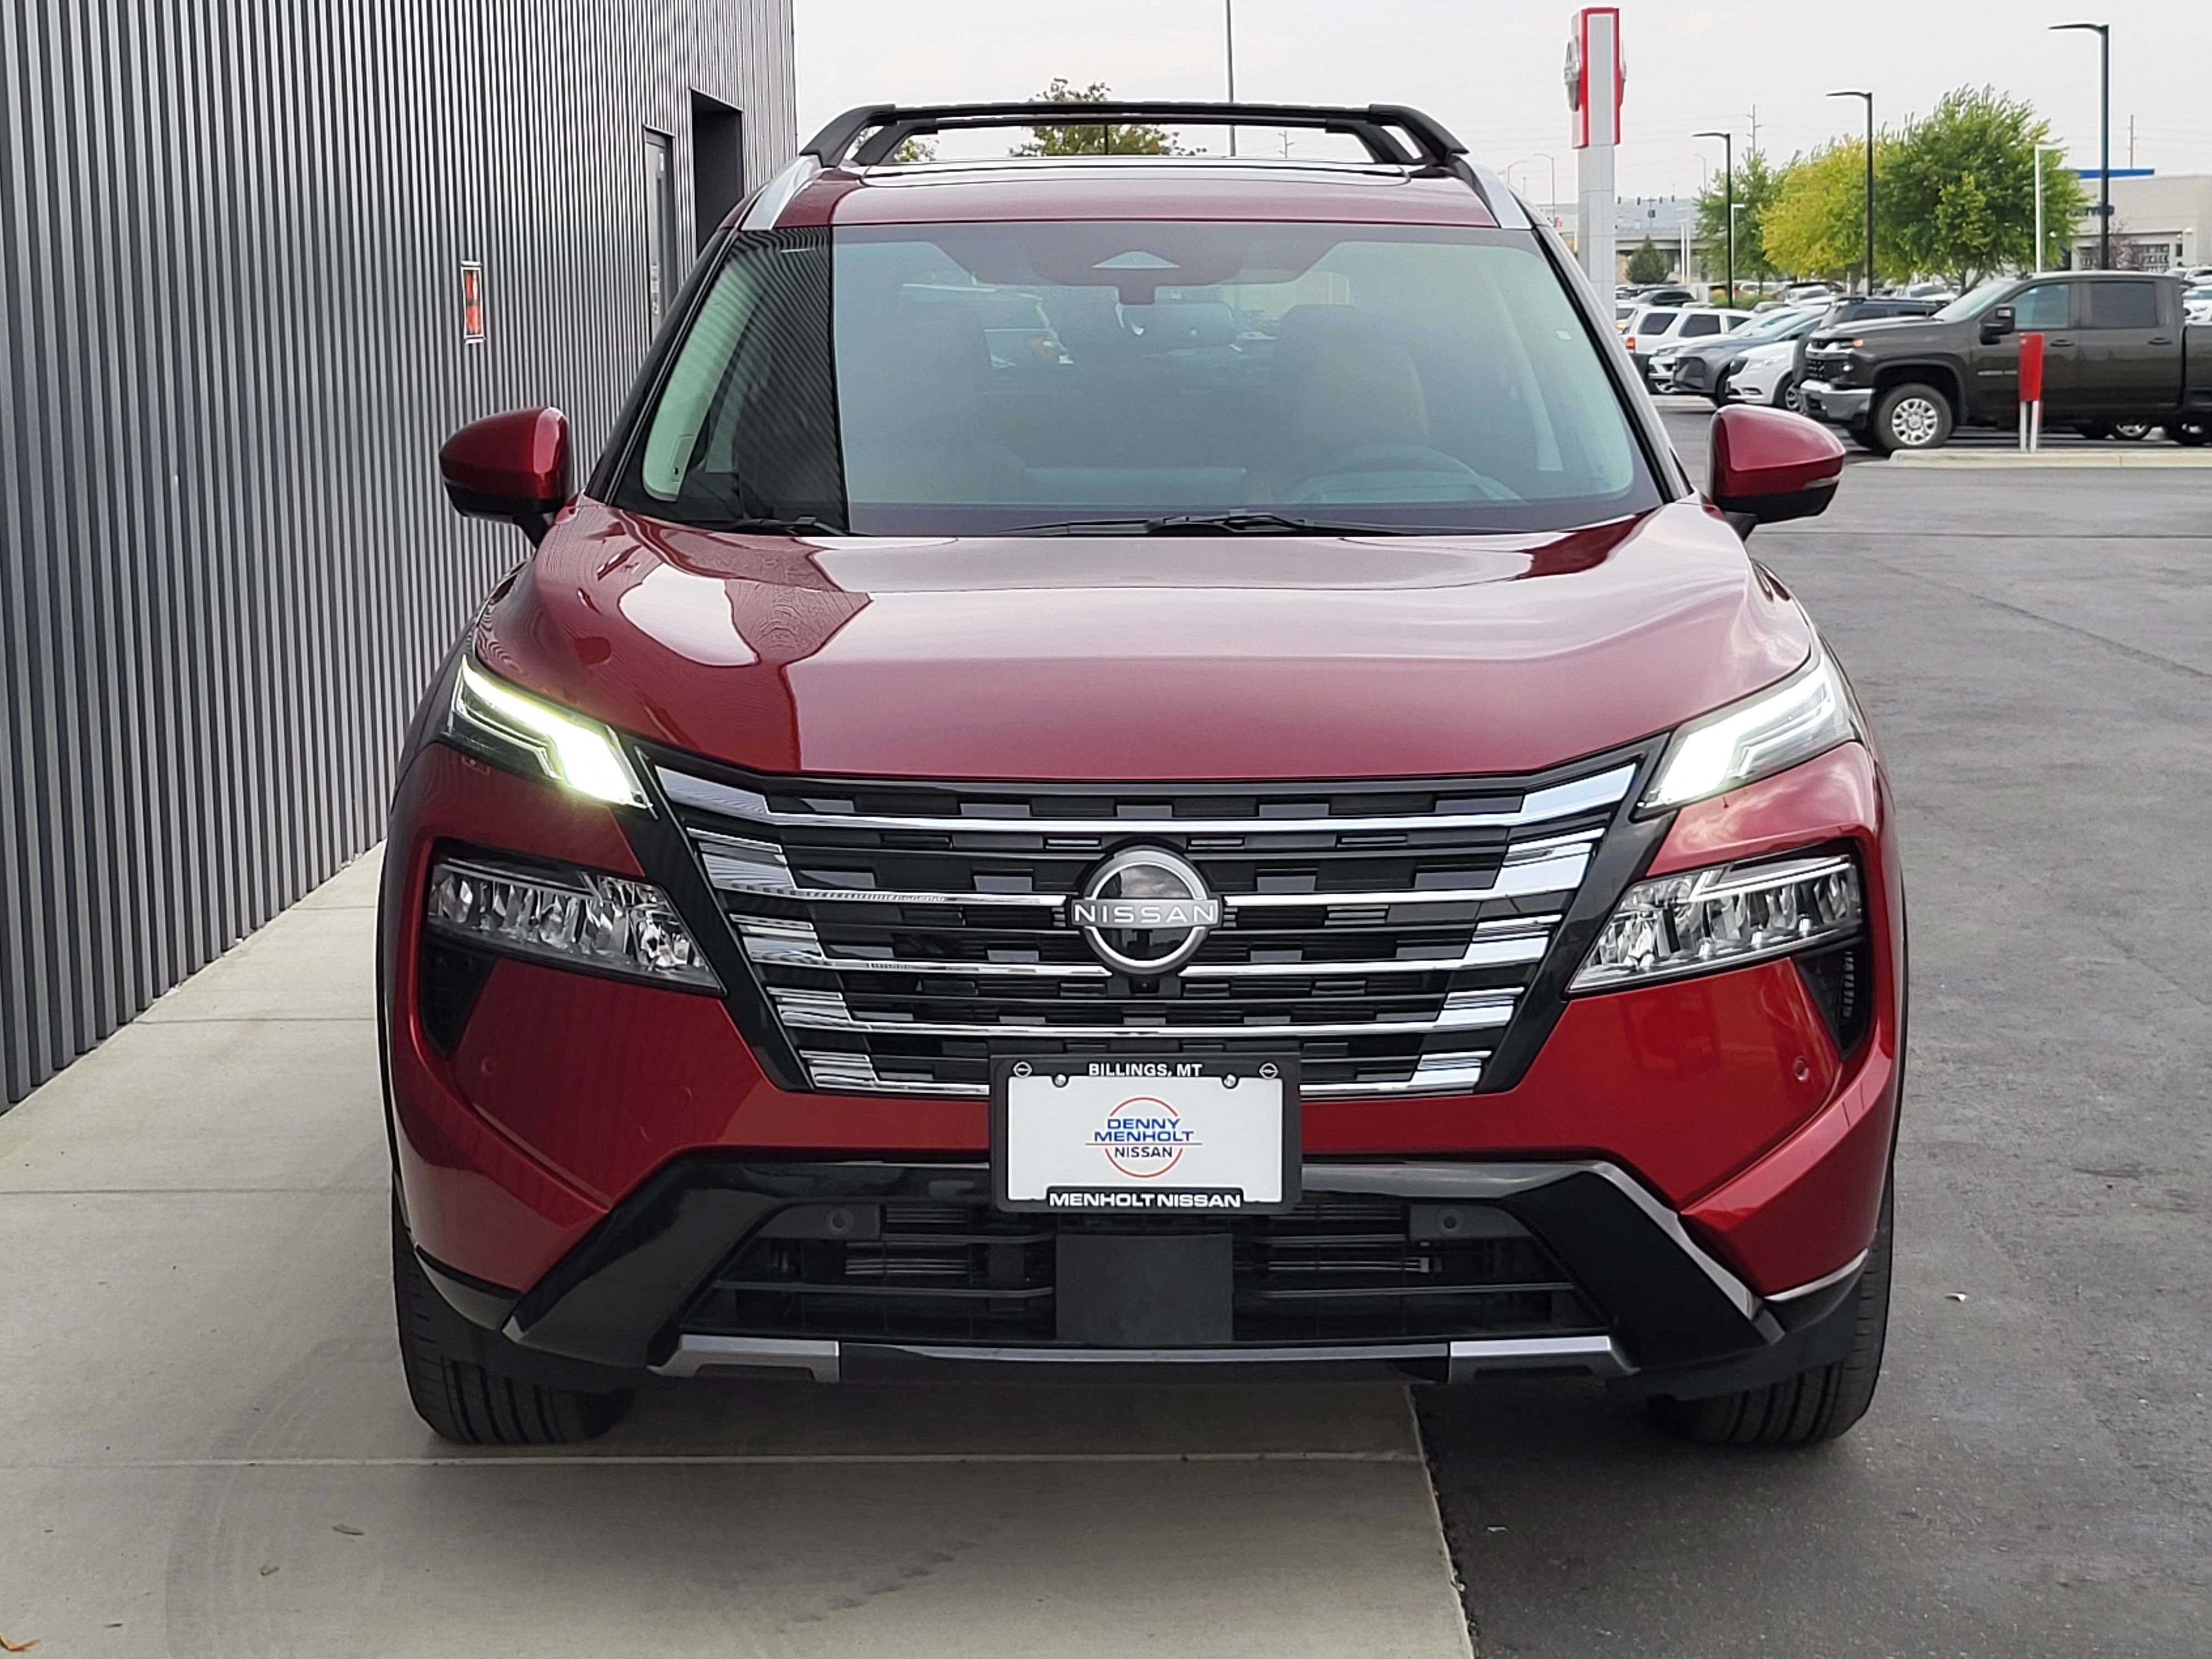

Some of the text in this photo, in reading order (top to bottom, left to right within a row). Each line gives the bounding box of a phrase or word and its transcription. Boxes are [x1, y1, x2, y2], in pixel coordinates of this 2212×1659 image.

[1074, 905, 1215, 923] NISSAN
[1088, 1063, 1203, 1077] BILLINGS, MT
[1107, 1119, 1180, 1129] DENNY
[1094, 1131, 1194, 1141] MENHOLT
[1115, 1147, 1172, 1157] NISSAN
